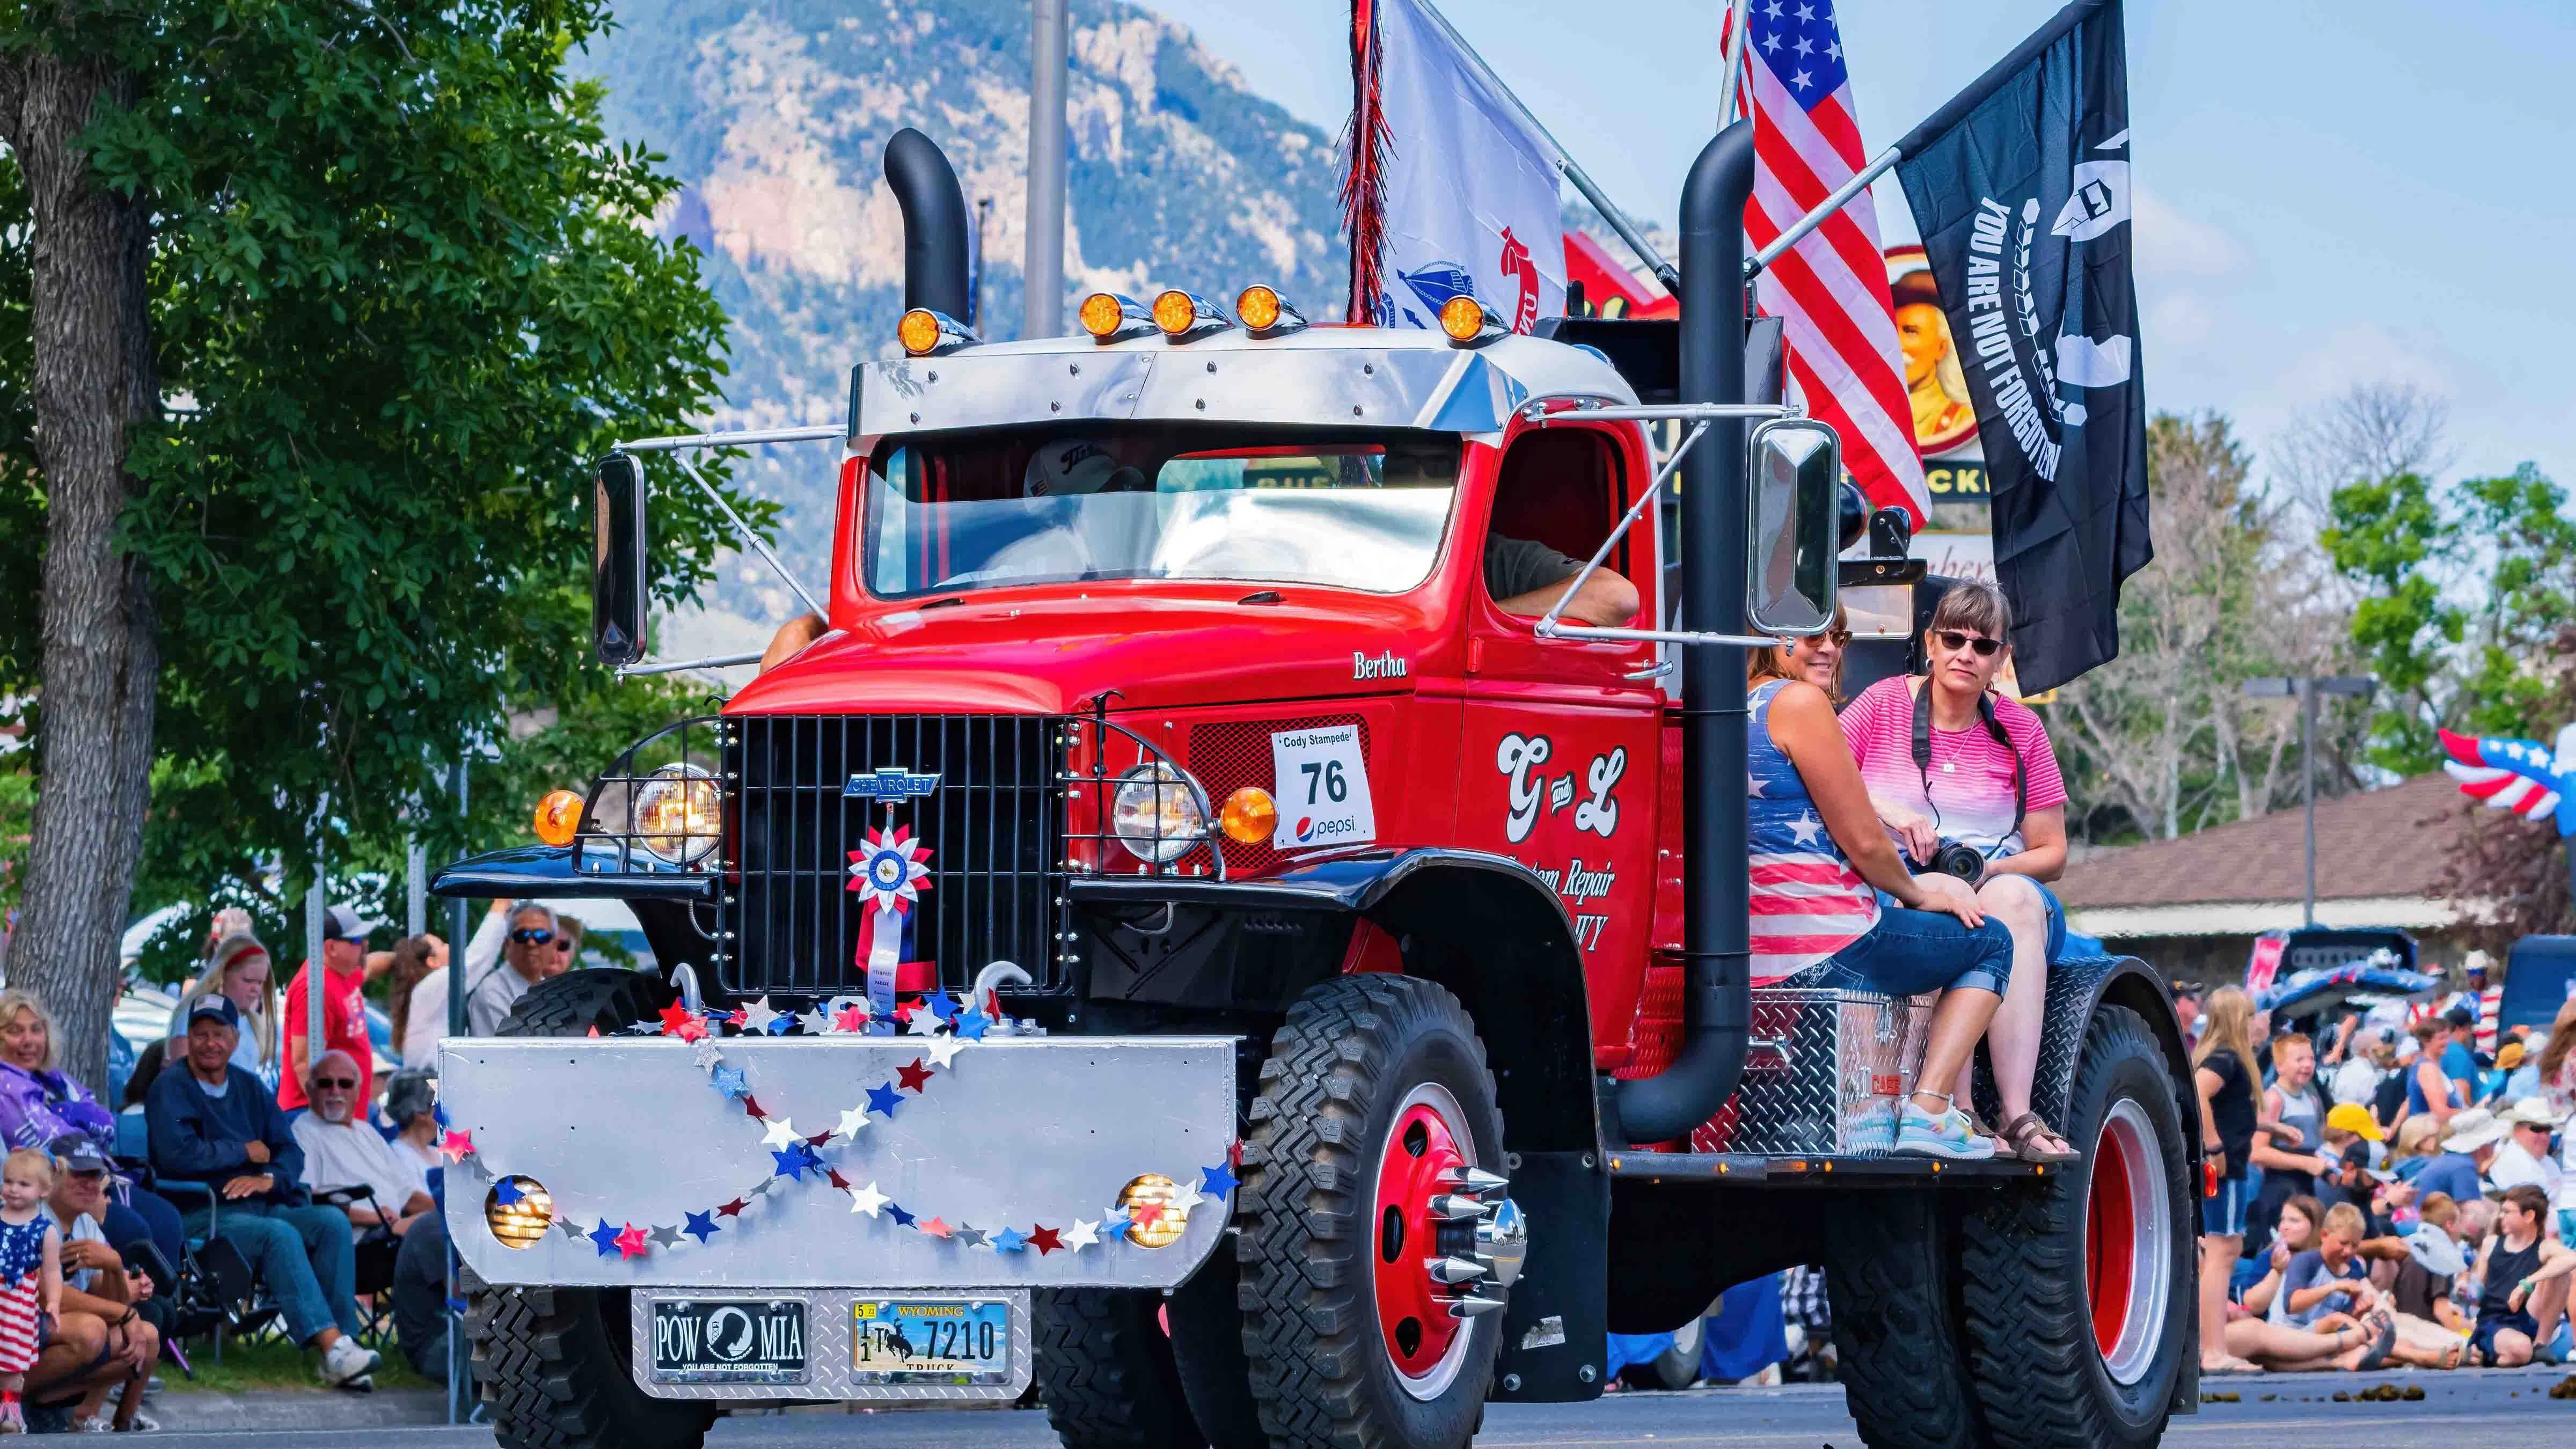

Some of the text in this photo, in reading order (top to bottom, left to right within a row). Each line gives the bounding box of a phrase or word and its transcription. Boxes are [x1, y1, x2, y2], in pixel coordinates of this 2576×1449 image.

[1967, 196, 2062, 482] YOU ARE NOT FORGOTTEN
[1352, 648, 1407, 679] Bertha
[1283, 731, 1350, 749] Cody Stampede
[852, 779, 930, 792] CHEVROLET
[1300, 759, 1348, 805] 76
[1497, 734, 1625, 843] G and L
[1317, 815, 1356, 838] pepsi
[1561, 858, 1616, 905] Repair
[1575, 914, 1609, 951] WY
[858, 1305, 863, 1317] 5
[897, 1305, 964, 1318] WYOMING
[656, 1315, 804, 1362] POW MIA
[923, 1321, 993, 1360] 7210
